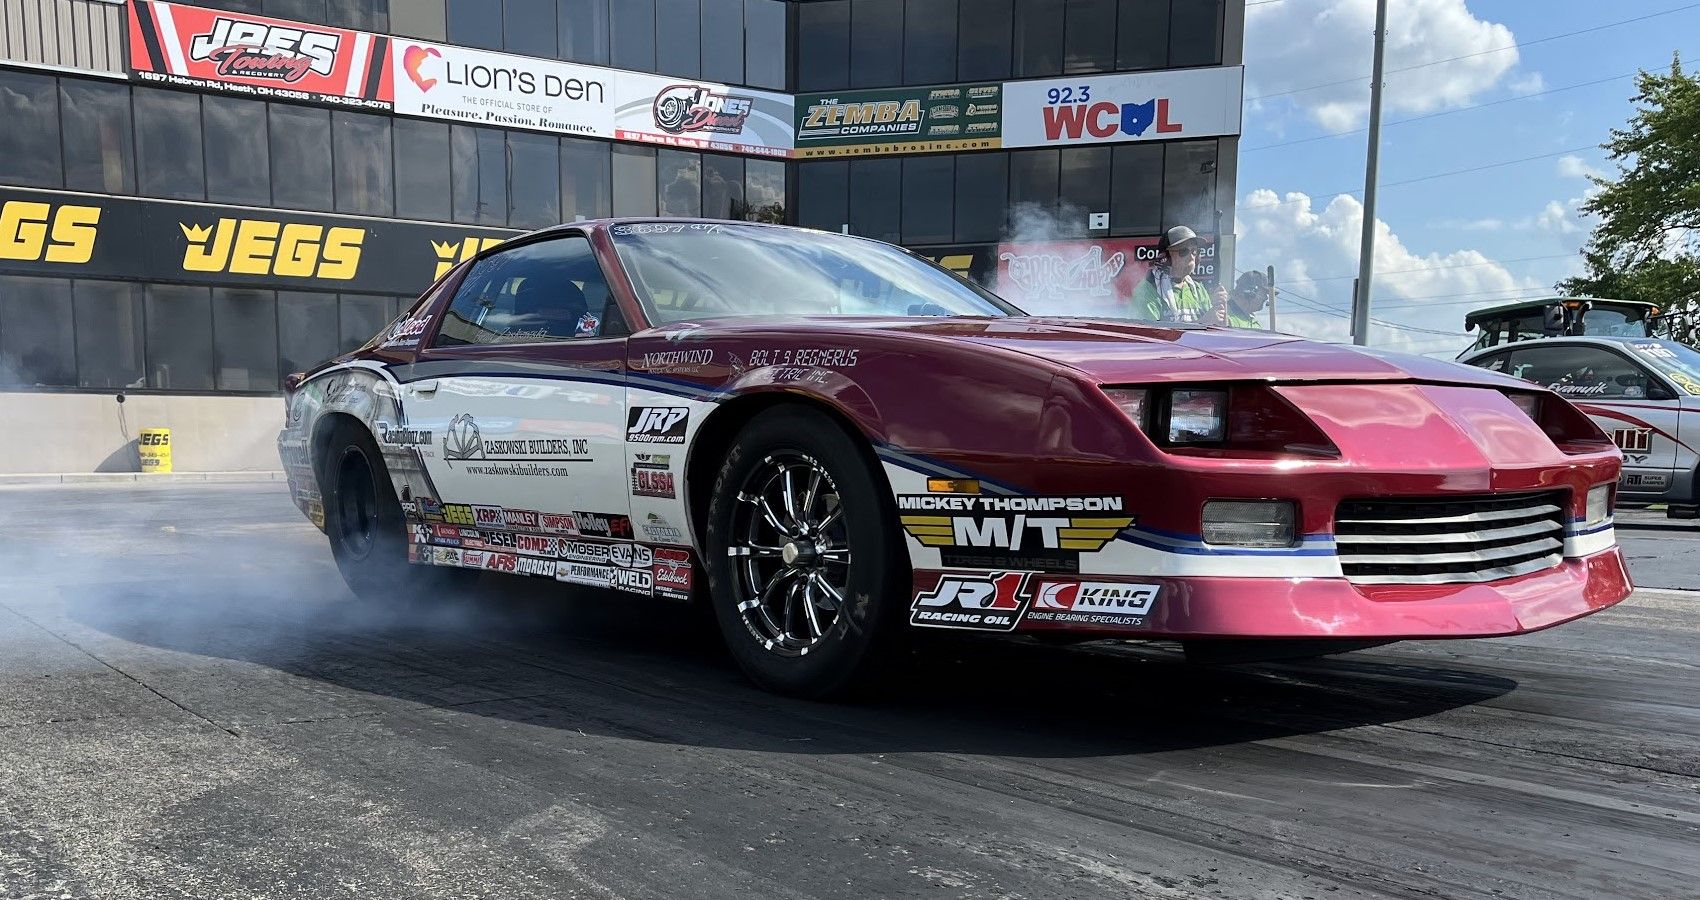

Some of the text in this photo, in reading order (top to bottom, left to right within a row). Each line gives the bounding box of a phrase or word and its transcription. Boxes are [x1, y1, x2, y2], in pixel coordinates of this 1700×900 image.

[209, 44, 312, 81] Towing
[240, 70, 285, 78] RECOVERY
[169, 76, 206, 87] Hebron
[207, 80, 223, 90] Rd,
[258, 88, 273, 96] OH
[820, 98, 838, 106] THE
[1047, 86, 1090, 105] 92.3
[462, 96, 553, 114] THE OFFICIAL STORE OF
[421, 103, 597, 134] Pleasure. Passion. Romance.
[805, 100, 921, 127] ZEMBA
[840, 123, 917, 135] COMPANIES
[805, 141, 990, 157] www.zembabrosinc.com
[181, 217, 366, 280] JEGS
[642, 349, 714, 369] NORTHWIND
[749, 349, 781, 366] BOLT
[628, 407, 689, 434] JRP
[139, 433, 169, 446] JEGS
[628, 433, 684, 444] 9500rpm.com
[485, 439, 588, 457] ZASKOWSKI BUILDERS, INC
[466, 463, 569, 477] www.zaskowskibuilders.com
[898, 496, 1123, 512] MICKEY THOMPSON
[442, 504, 476, 525] JEGS
[475, 508, 497, 523] XRP
[544, 516, 575, 529] SIMPSON
[574, 512, 612, 537] Holley
[953, 514, 1070, 551] M/T
[484, 532, 517, 548] JESEL
[517, 535, 548, 551] COMP
[567, 542, 610, 558] MOSER
[612, 547, 650, 561] EVANS
[571, 565, 610, 580] PERFORMANCE
[619, 570, 652, 589] WELD
[618, 586, 651, 596] RACING
[918, 572, 1026, 610] JR1
[1078, 588, 1152, 609] KING
[918, 611, 1011, 626] RACING OIL
[1027, 611, 1143, 626] ENGINE BEARING SPECIALISTS
